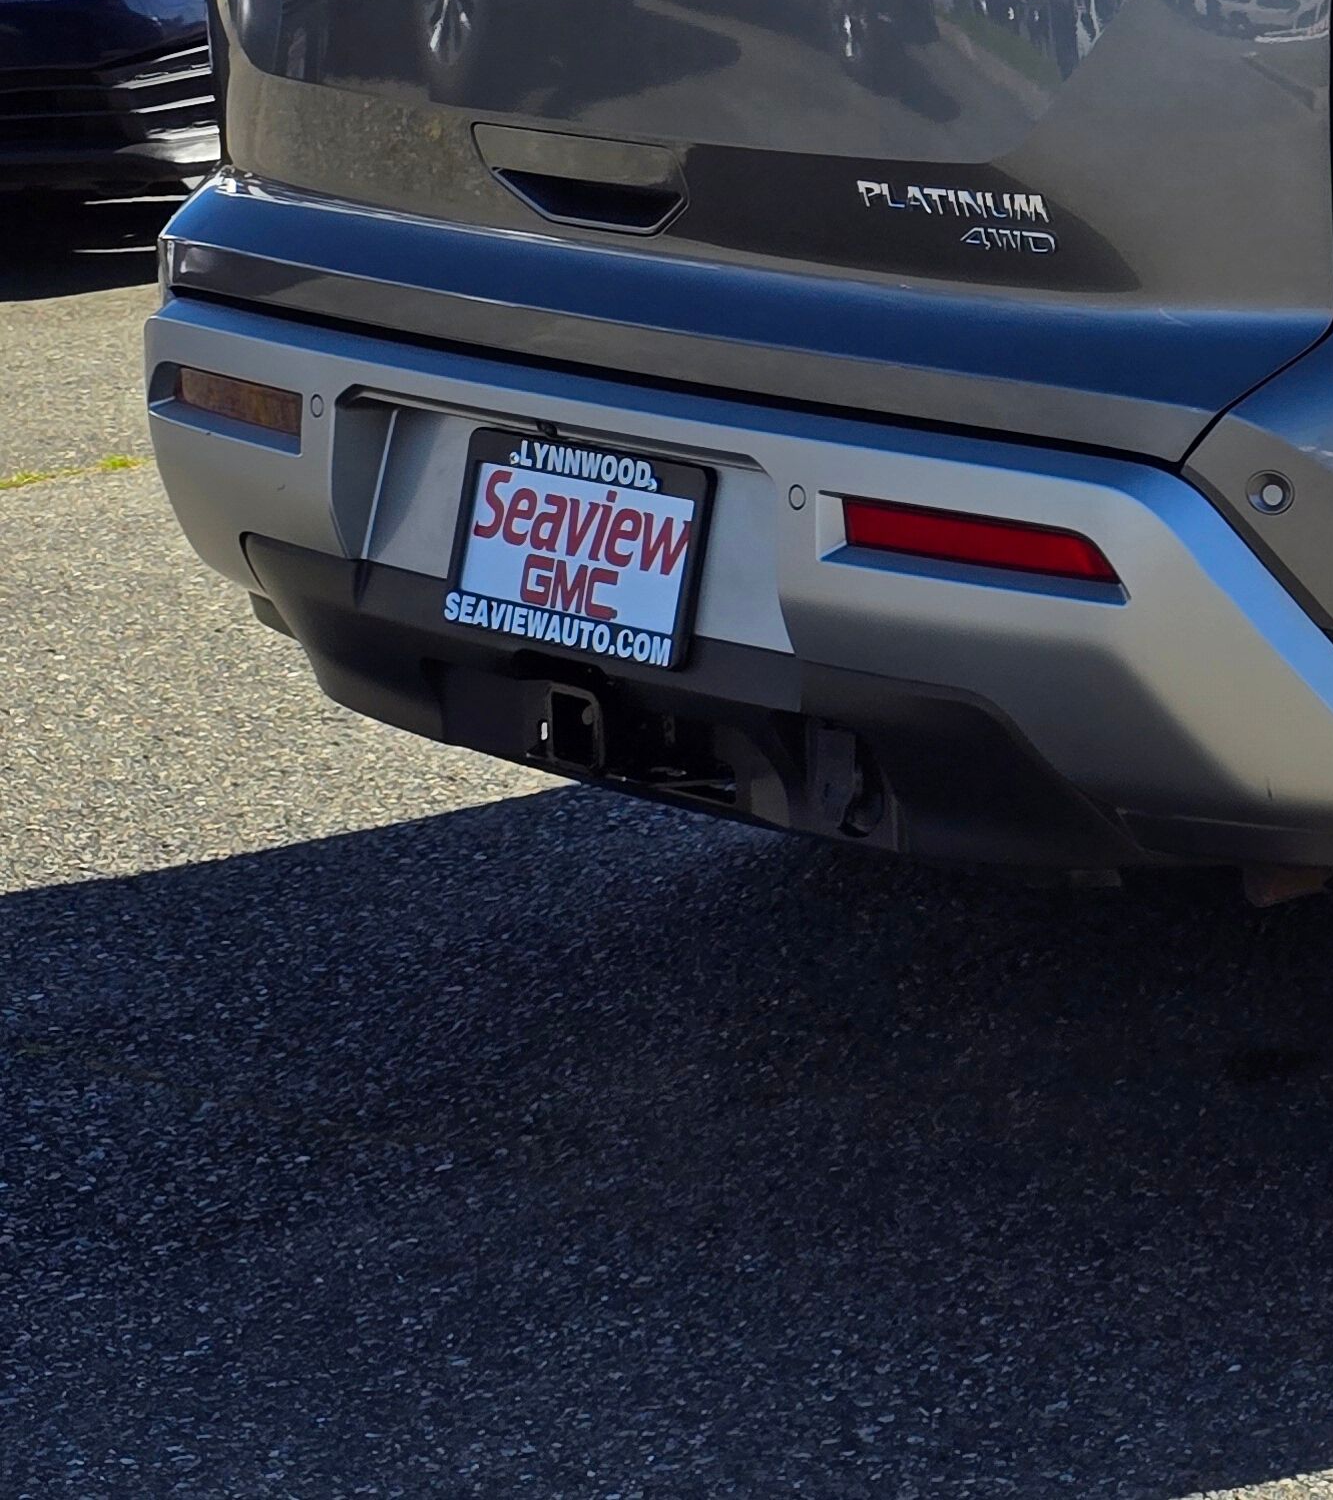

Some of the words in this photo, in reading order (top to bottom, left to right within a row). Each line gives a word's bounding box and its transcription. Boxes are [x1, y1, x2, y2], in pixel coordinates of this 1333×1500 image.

[857, 180, 1049, 223] PLATINUM
[960, 227, 1055, 252] 4WD
[519, 439, 652, 489] LYNNWOOD
[473, 469, 691, 576] Seaview
[519, 553, 619, 621] GMC
[444, 592, 672, 668] SEAVIEWAUTO.COM
